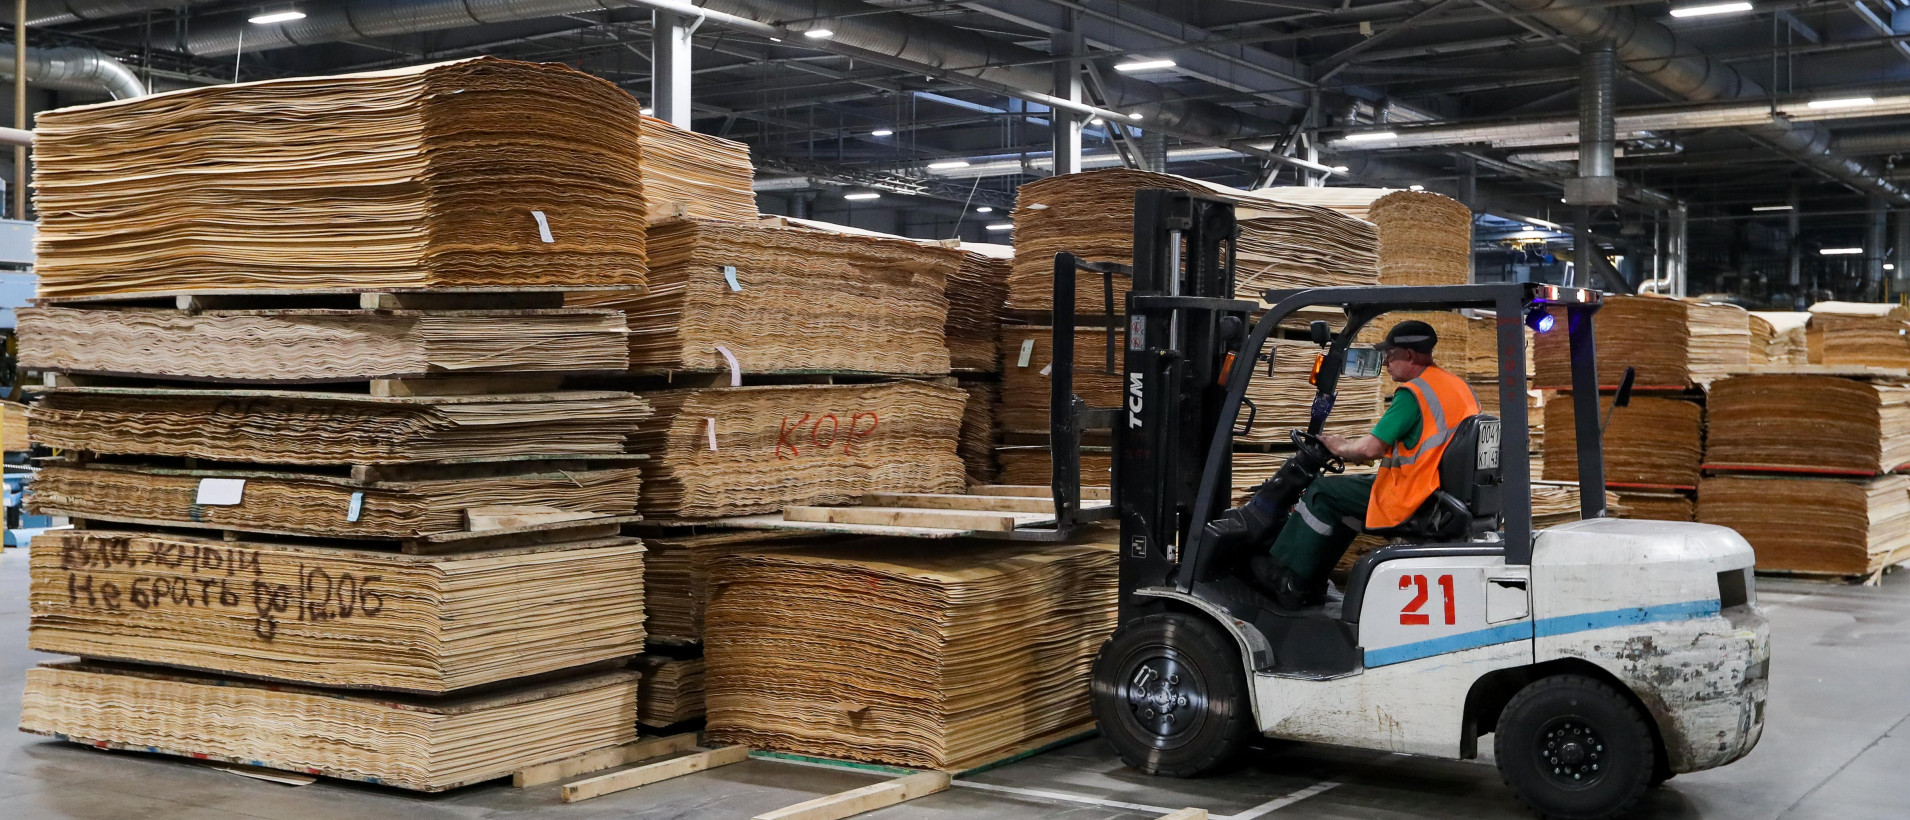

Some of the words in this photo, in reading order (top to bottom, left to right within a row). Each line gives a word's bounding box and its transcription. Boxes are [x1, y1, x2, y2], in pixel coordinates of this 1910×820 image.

[1128, 372, 1144, 429] TCM
[68, 572, 121, 609] Не
[130, 576, 241, 609] брать
[1398, 574, 1456, 626] 21
